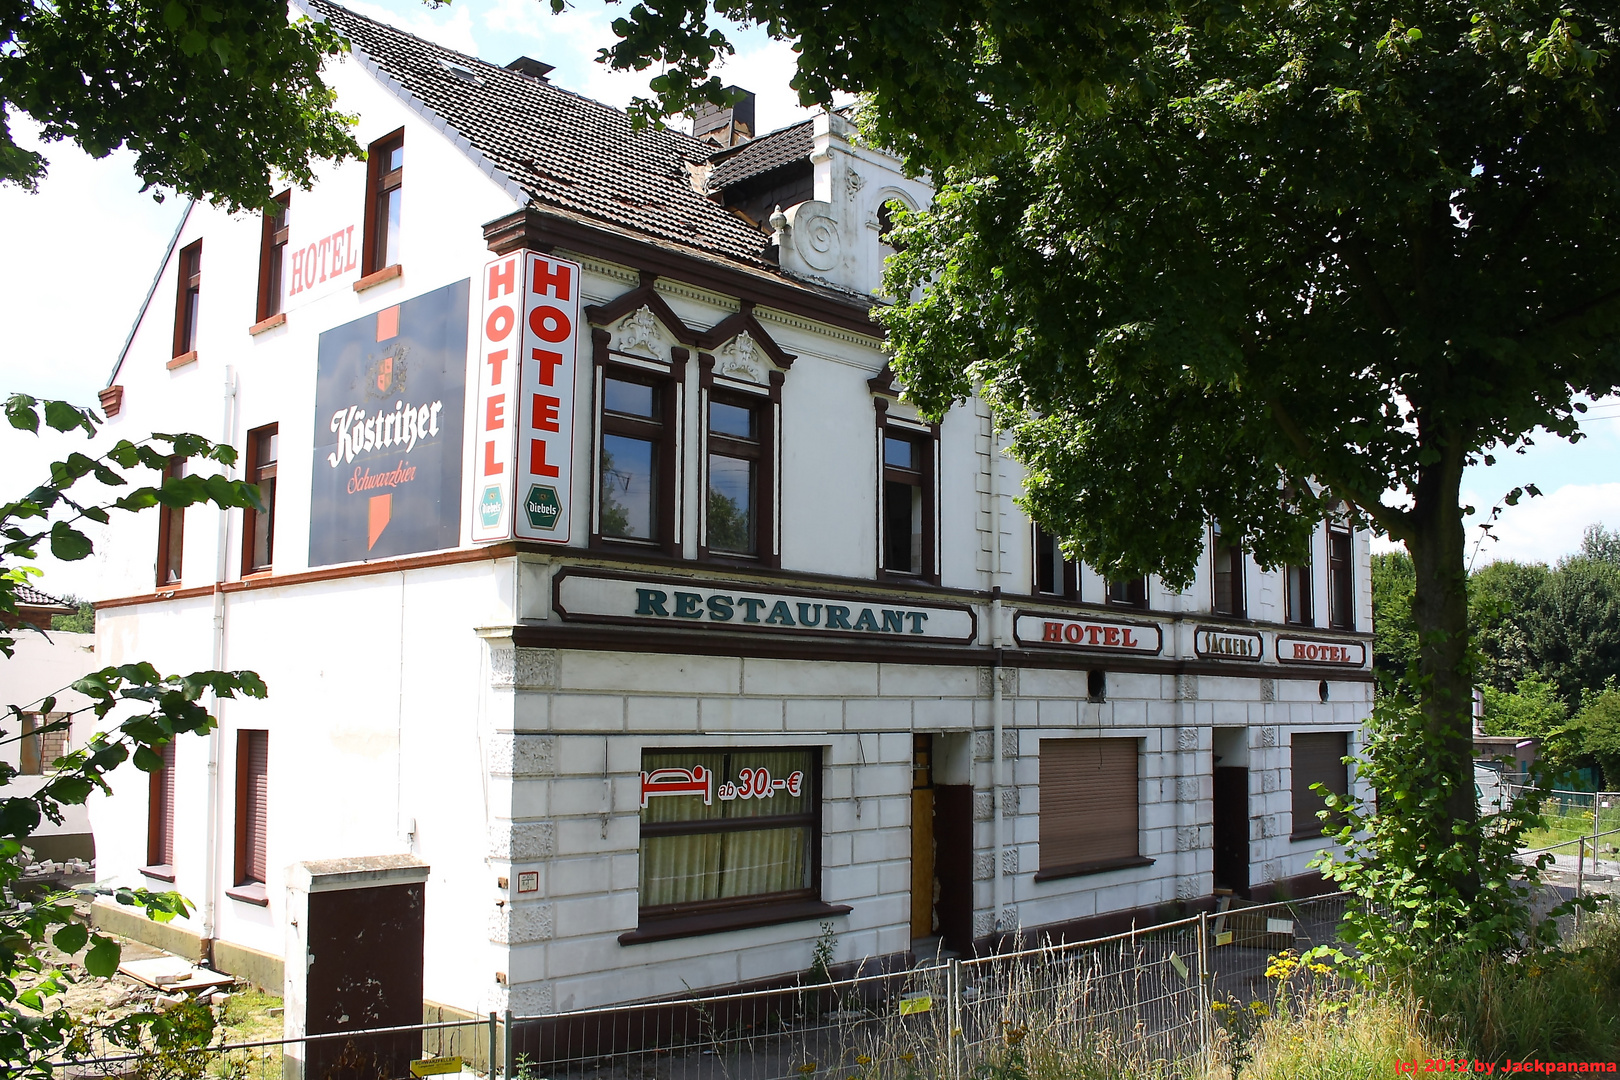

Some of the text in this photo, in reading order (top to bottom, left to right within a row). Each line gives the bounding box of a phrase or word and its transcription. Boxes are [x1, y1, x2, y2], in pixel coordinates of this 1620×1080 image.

[289, 224, 357, 297] HOTEL
[484, 258, 516, 477] HOTEL
[528, 258, 572, 478] HOTEL
[347, 459, 417, 494] Schwarzbier
[482, 501, 501, 514] Diebels
[529, 501, 557, 515] Diebels
[634, 588, 929, 635] RESTAURANT
[1043, 621, 1138, 648] HOTEL
[1293, 643, 1351, 662] HOTEL
[718, 781, 737, 799] ab
